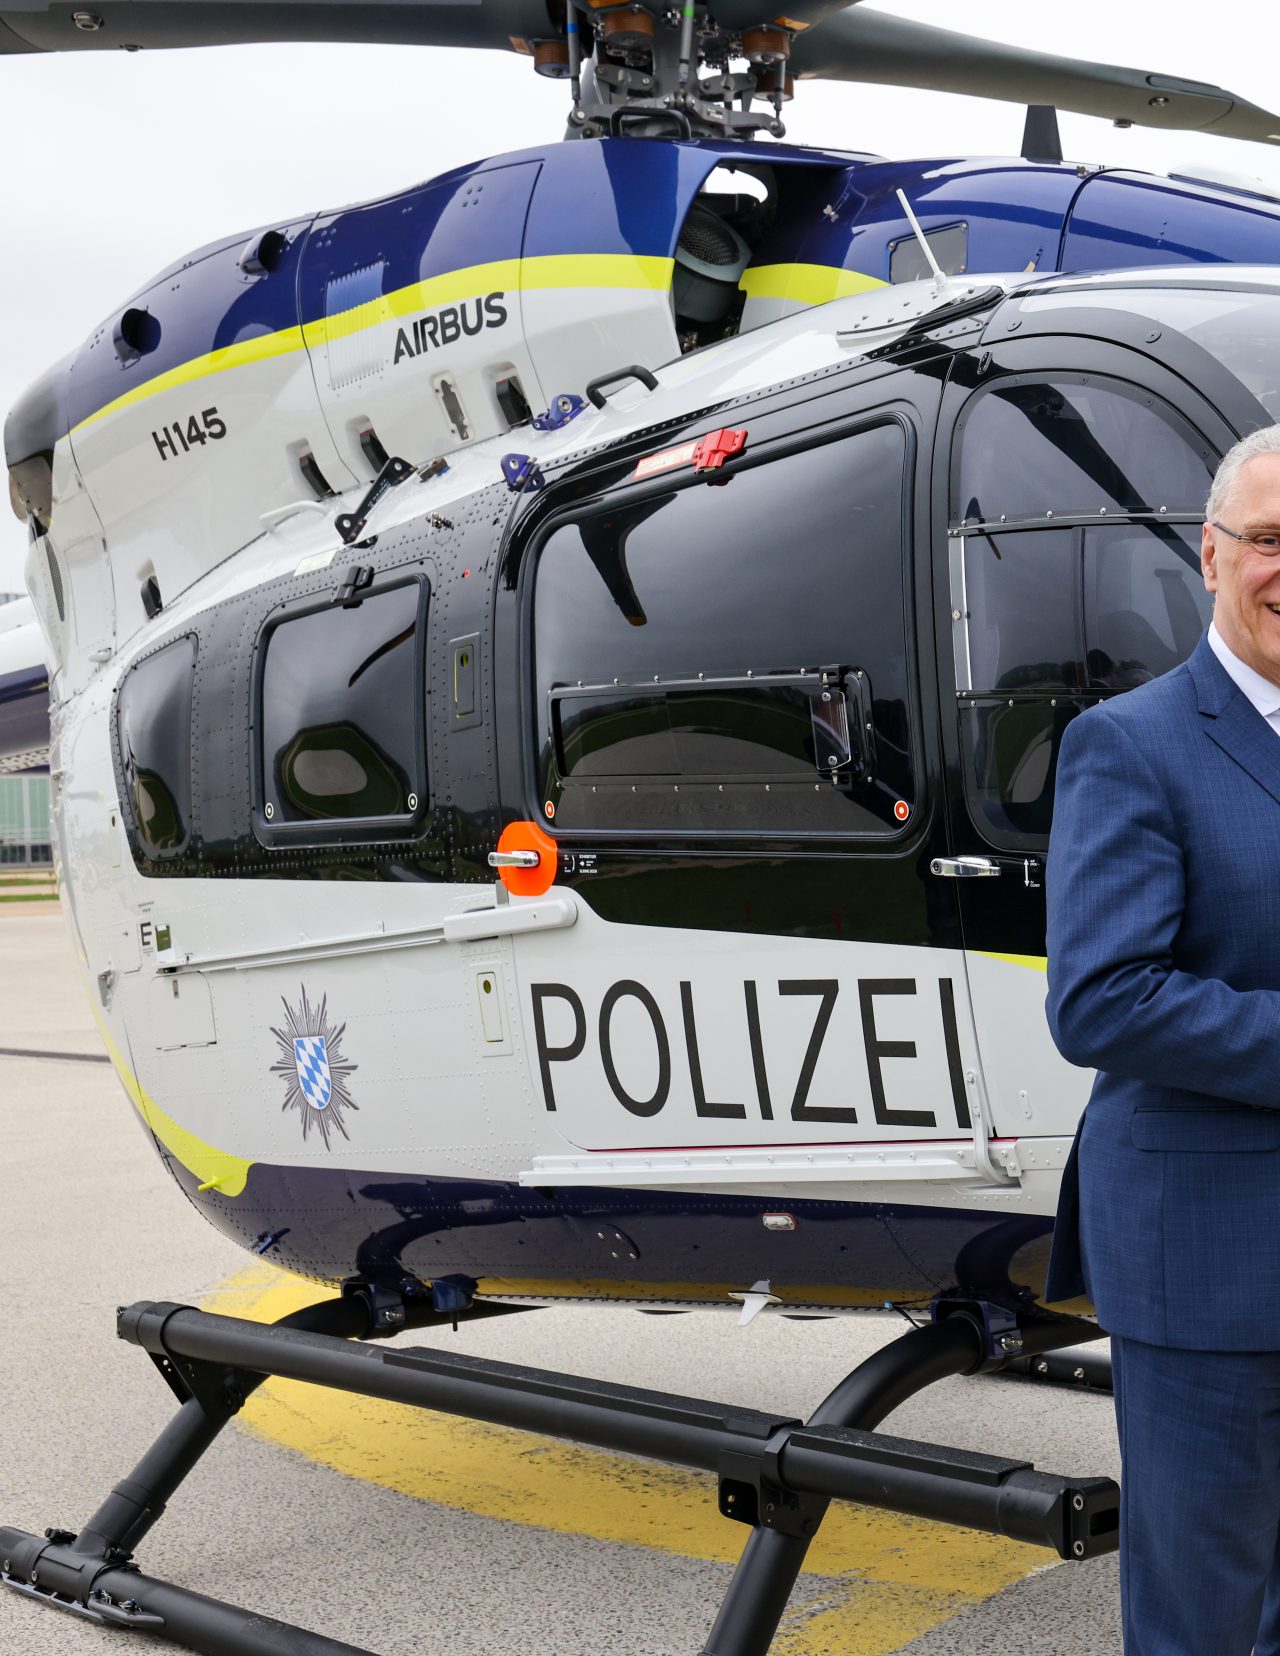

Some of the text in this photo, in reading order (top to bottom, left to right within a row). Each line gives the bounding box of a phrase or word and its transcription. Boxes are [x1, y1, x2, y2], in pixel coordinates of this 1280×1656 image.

[394, 292, 507, 364] AIRBUS
[152, 407, 227, 460] H145
[140, 921, 152, 946] E
[531, 978, 973, 1130] POLIZEI
